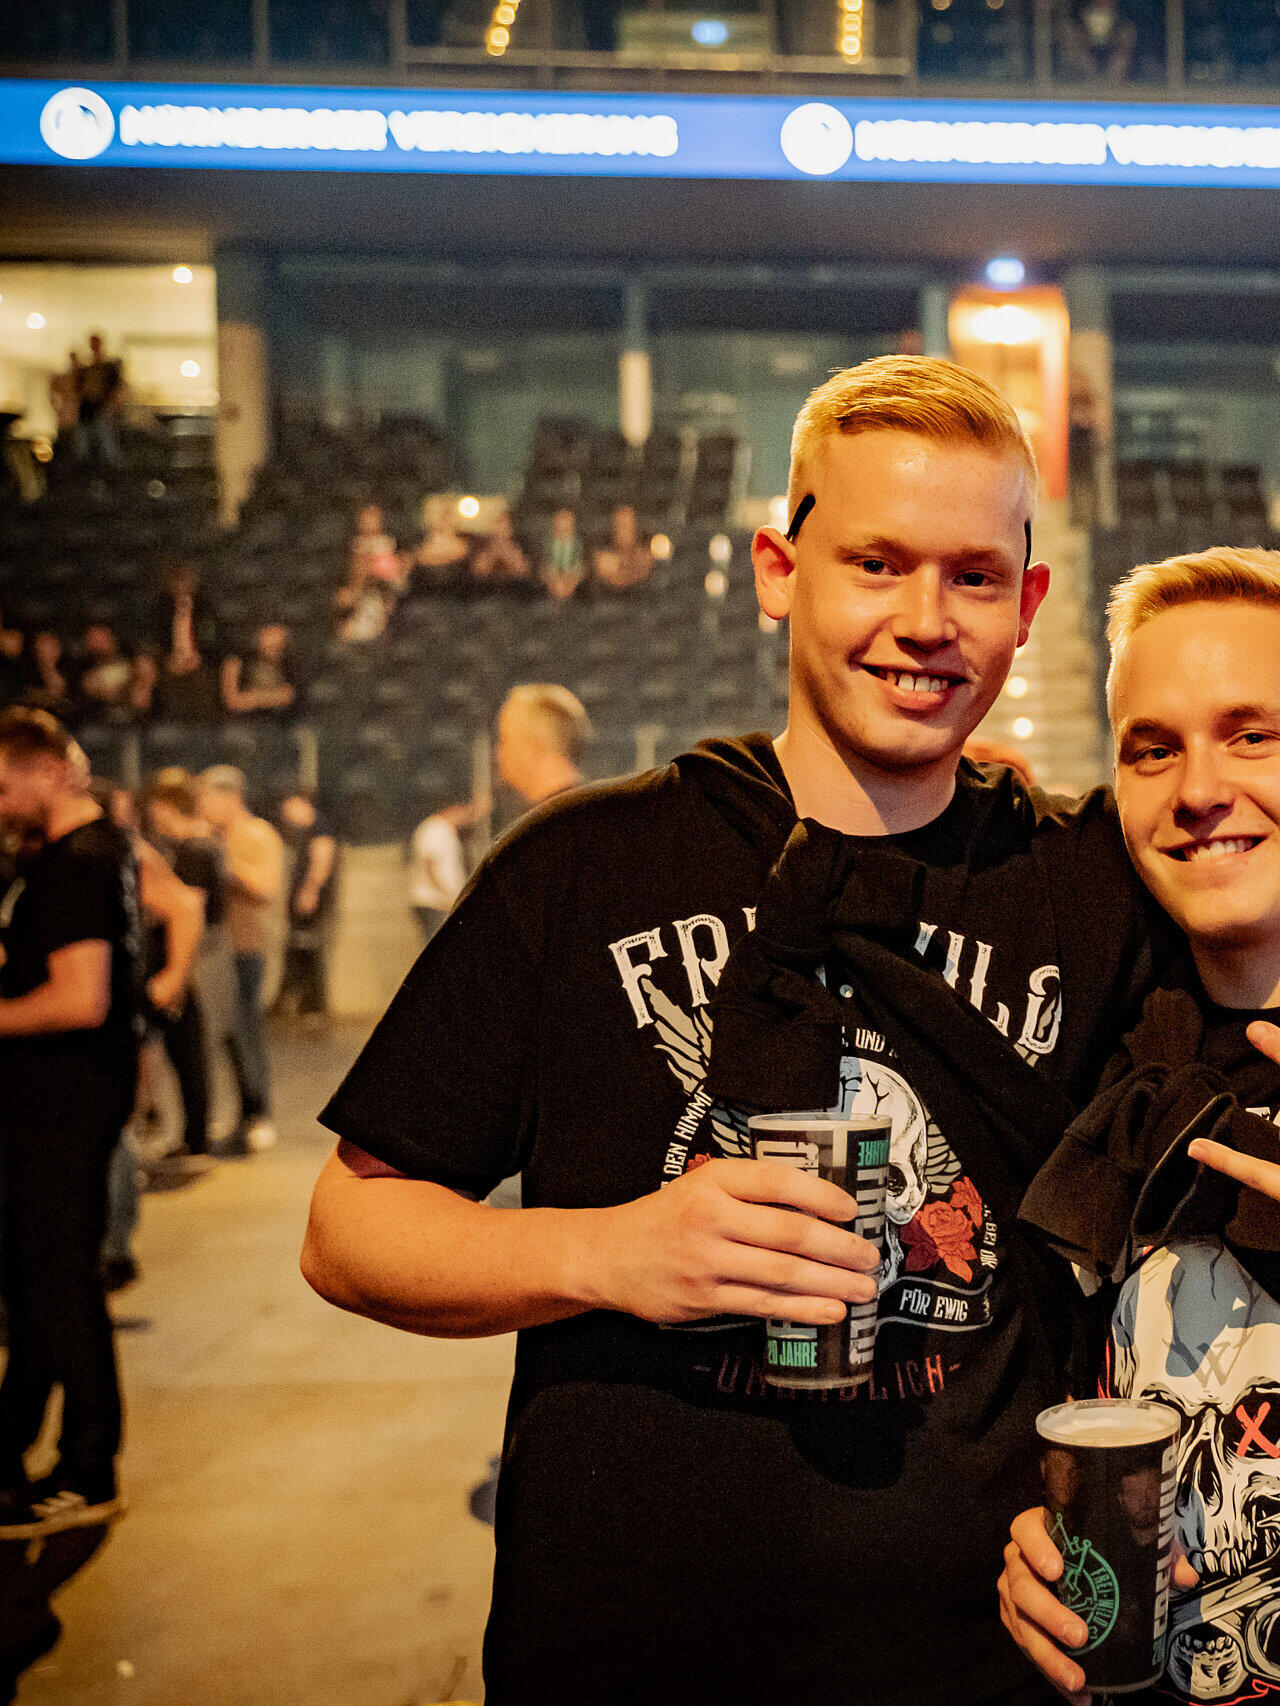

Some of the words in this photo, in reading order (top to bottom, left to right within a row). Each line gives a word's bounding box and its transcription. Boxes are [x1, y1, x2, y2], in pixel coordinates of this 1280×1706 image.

[855, 1028, 885, 1052] UND
[663, 1142, 688, 1175] DEN
[984, 1222, 998, 1246] BEI
[900, 1288, 931, 1315] FÜR
[934, 1295, 968, 1322] EWIG
[780, 1341, 817, 1367] JAHRE
